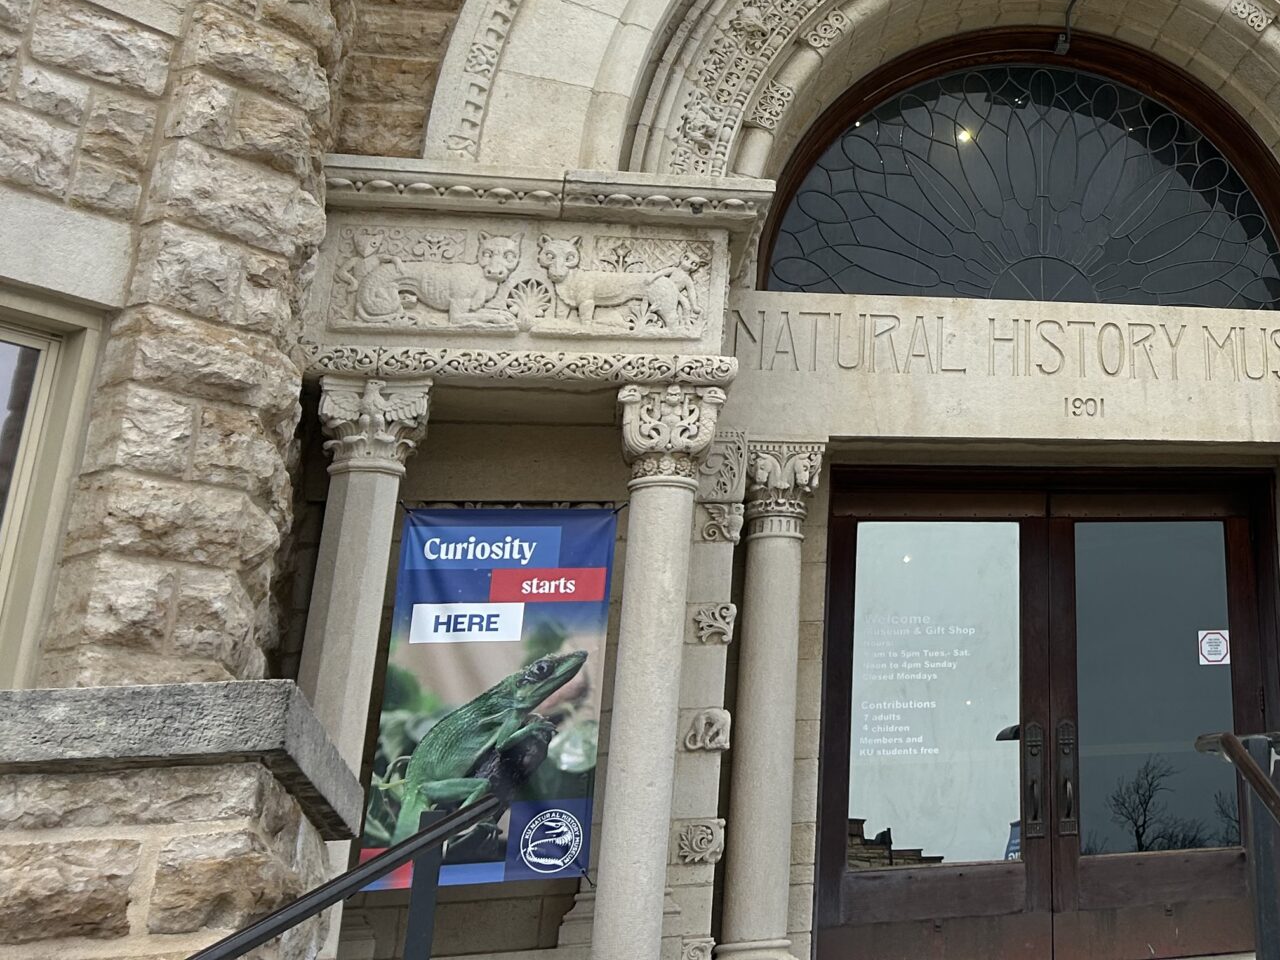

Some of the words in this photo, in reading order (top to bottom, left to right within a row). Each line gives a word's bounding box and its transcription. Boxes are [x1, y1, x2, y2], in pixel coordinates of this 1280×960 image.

[731, 309, 967, 374] NATURAL
[988, 317, 1187, 381] HISTORY
[1063, 397, 1105, 418] 1901
[423, 535, 538, 566] Curiosity
[521, 577, 576, 595] starts
[433, 614, 500, 633] HERE
[913, 627, 922, 635] &
[925, 626, 945, 635] Gift
[948, 625, 976, 636] Shop
[889, 650, 898, 658] to
[901, 649, 920, 659] 5pm
[953, 648, 971, 657] Sat.
[890, 661, 899, 670] to
[901, 661, 921, 671] 4pm
[924, 660, 957, 670] Sunday
[897, 672, 938, 681] Mondays
[861, 700, 937, 710] Contributions
[872, 713, 901, 722] adults
[872, 724, 910, 733] children
[859, 736, 903, 745] Members
[905, 735, 923, 743] and
[859, 748, 874, 756] KU
[876, 747, 918, 756] students
[920, 746, 940, 755] free
[530, 812, 560, 829] NATURAL
[562, 813, 580, 836] HISTORY
[524, 829, 532, 840] KU
[563, 836, 580, 864] MUSEUM
